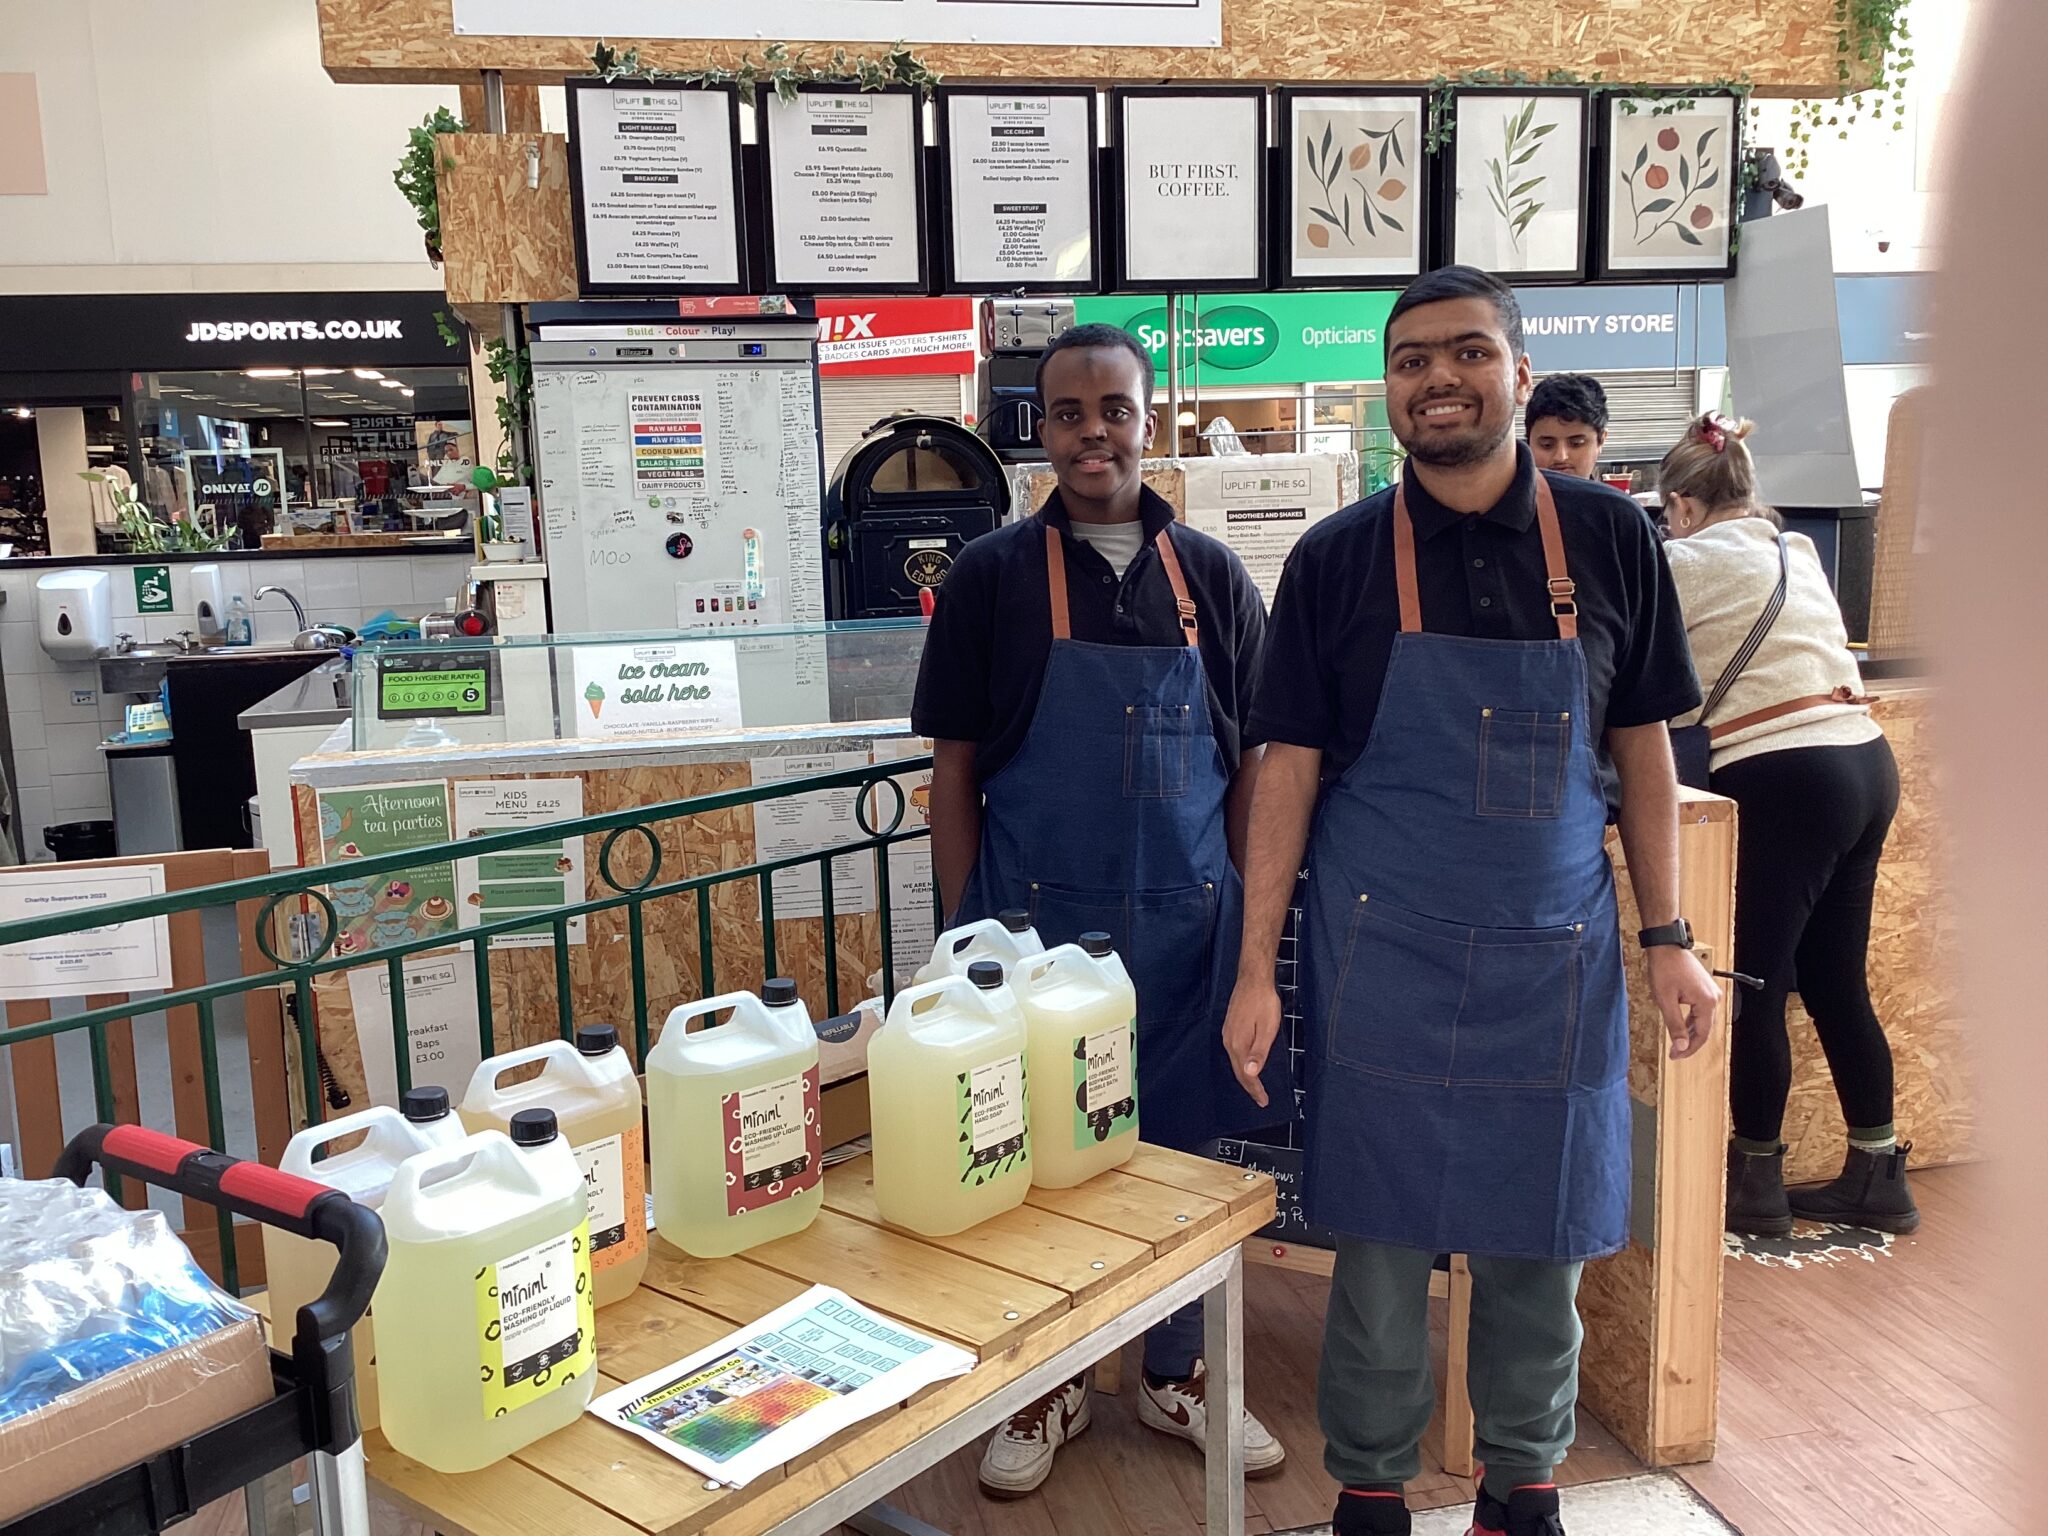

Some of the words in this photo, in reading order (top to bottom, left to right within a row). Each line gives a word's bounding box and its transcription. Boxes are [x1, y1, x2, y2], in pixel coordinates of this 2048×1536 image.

[1150, 164, 1182, 179] BUT
[1187, 164, 1238, 181] FIRST,
[1158, 182, 1230, 197] COFFEE.
[185, 320, 403, 342] JDSPORTS.CO.UK
[627, 327, 654, 336] Build
[666, 327, 700, 335] Colour
[712, 326, 736, 336] Play!
[1521, 316, 1600, 335] MUNITY
[1605, 314, 1674, 334] STORE
[833, 342, 855, 351] BACK
[858, 340, 887, 350] ISSUES
[889, 337, 927, 346] POSTERS
[929, 333, 967, 343] T-SHIRTS
[1302, 326, 1376, 349] Opticians
[824, 351, 859, 360] BADGES
[860, 349, 890, 358] CARDS
[892, 347, 911, 355] AND
[913, 345, 940, 353] MUCH
[942, 342, 972, 351] MORE!!
[632, 403, 701, 411] CONTAMINATION
[202, 484, 237, 494] ONLY
[237, 484, 250, 492] AT
[1224, 481, 1257, 491] UPLIFT
[1272, 480, 1290, 488] THE
[917, 554, 942, 564] KING
[618, 664, 645, 680] ice
[650, 662, 709, 678] cream
[620, 684, 664, 704] sold
[667, 683, 711, 702] here
[604, 722, 639, 730] CHOCOLATE
[504, 791, 527, 799] KIDS
[361, 794, 443, 818] Afternoon
[495, 800, 528, 809] MENU
[537, 800, 560, 808] £4.25
[363, 819, 388, 833] tea
[393, 814, 442, 836] parties
[422, 974, 437, 982] THE
[407, 1023, 448, 1036] reakfast
[416, 1040, 440, 1050] Baps
[416, 1051, 444, 1064] £3.00
[1088, 1065, 1119, 1080] ECO-FRIENDLY
[974, 1100, 1009, 1118] ECO-FRIENDLY
[975, 1116, 989, 1124] HAND
[990, 1110, 1002, 1119] SOAP
[744, 1123, 788, 1140] ECO-FRIENDLY
[745, 1135, 772, 1147] WASHING
[783, 1125, 800, 1135] LIQUID
[503, 1295, 556, 1324] ECO-FRIENDLY
[504, 1313, 537, 1331] WASHING
[539, 1308, 548, 1316] UP
[550, 1296, 571, 1312] LIQUID
[647, 1395, 666, 1405] The
[667, 1377, 701, 1395] Ethical
[701, 1365, 726, 1378] Soap
